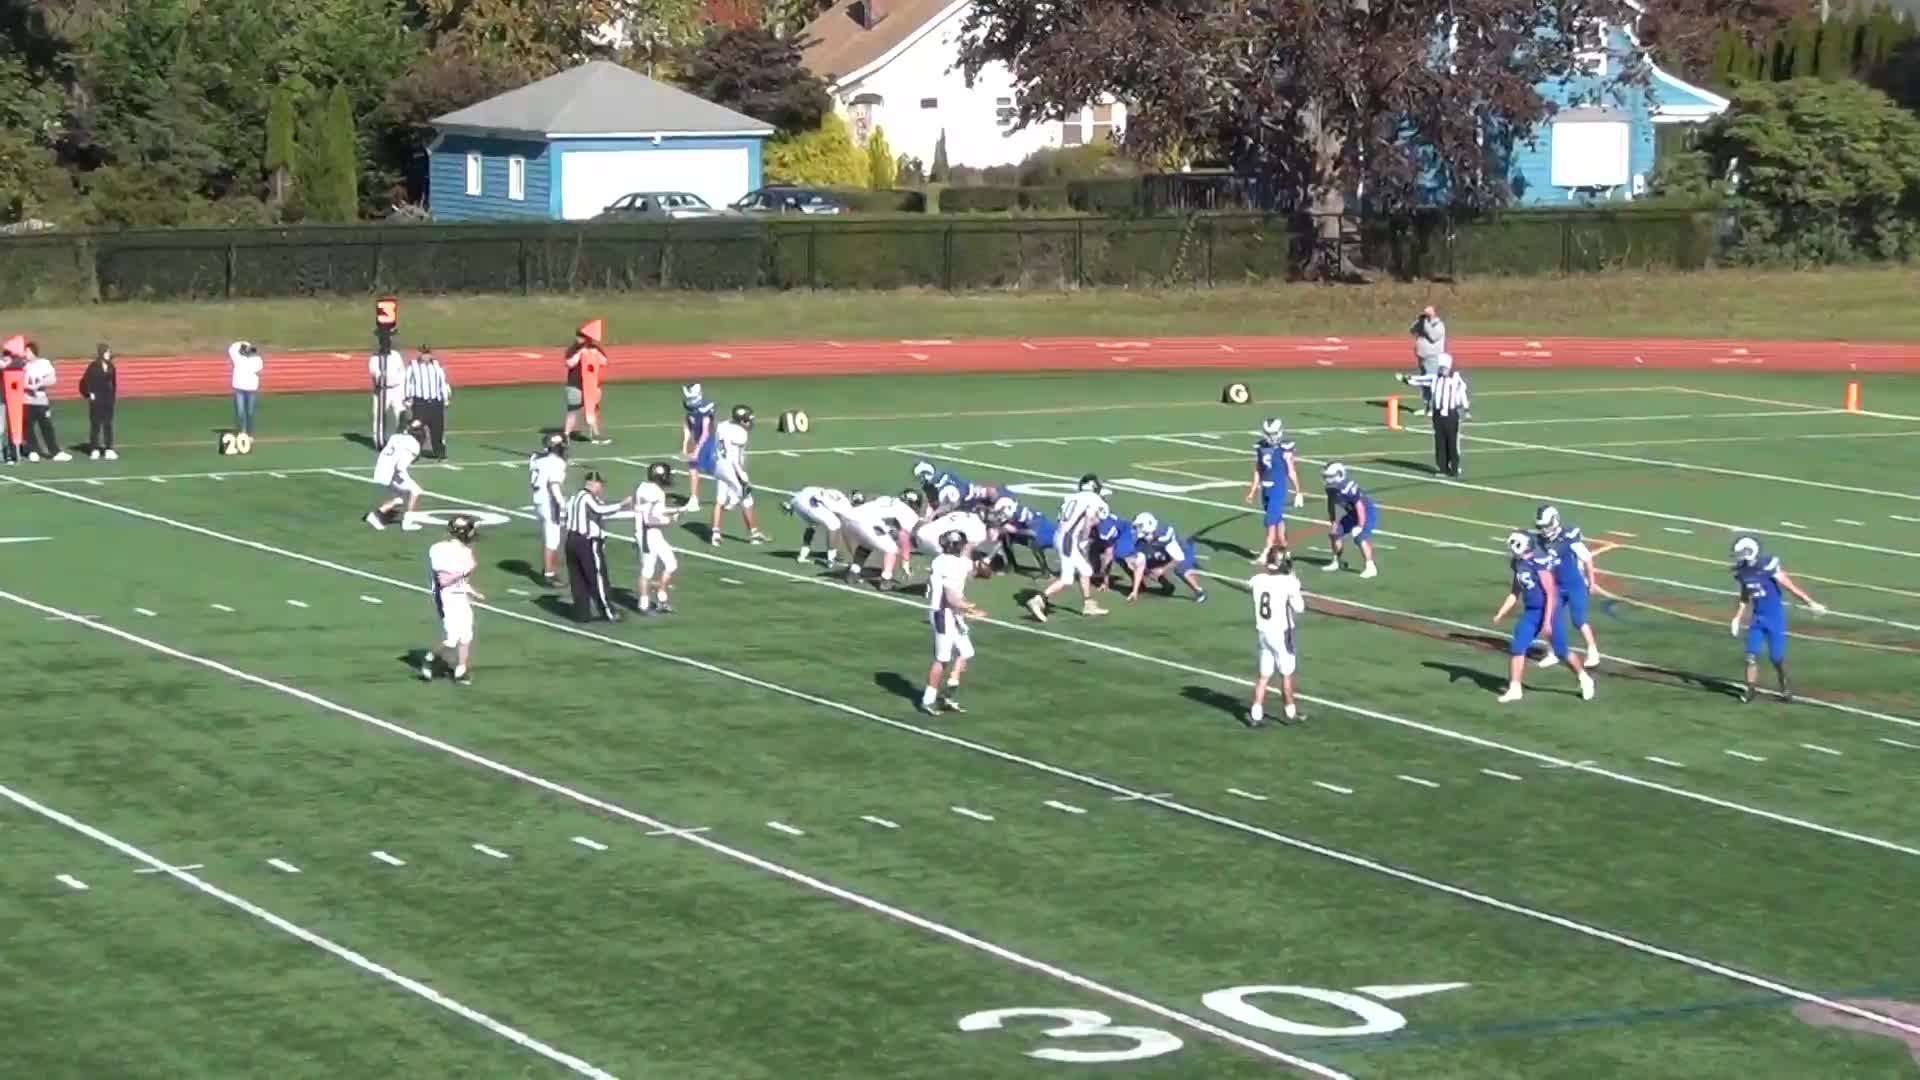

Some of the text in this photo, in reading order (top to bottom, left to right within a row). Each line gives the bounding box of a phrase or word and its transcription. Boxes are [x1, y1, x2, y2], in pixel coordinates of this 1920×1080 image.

[376, 300, 396, 324] 3
[1230, 383, 1249, 403] G
[786, 411, 809, 433] 10
[222, 432, 251, 455] 20
[1259, 591, 1272, 620] 8
[958, 983, 1408, 1063] 30
